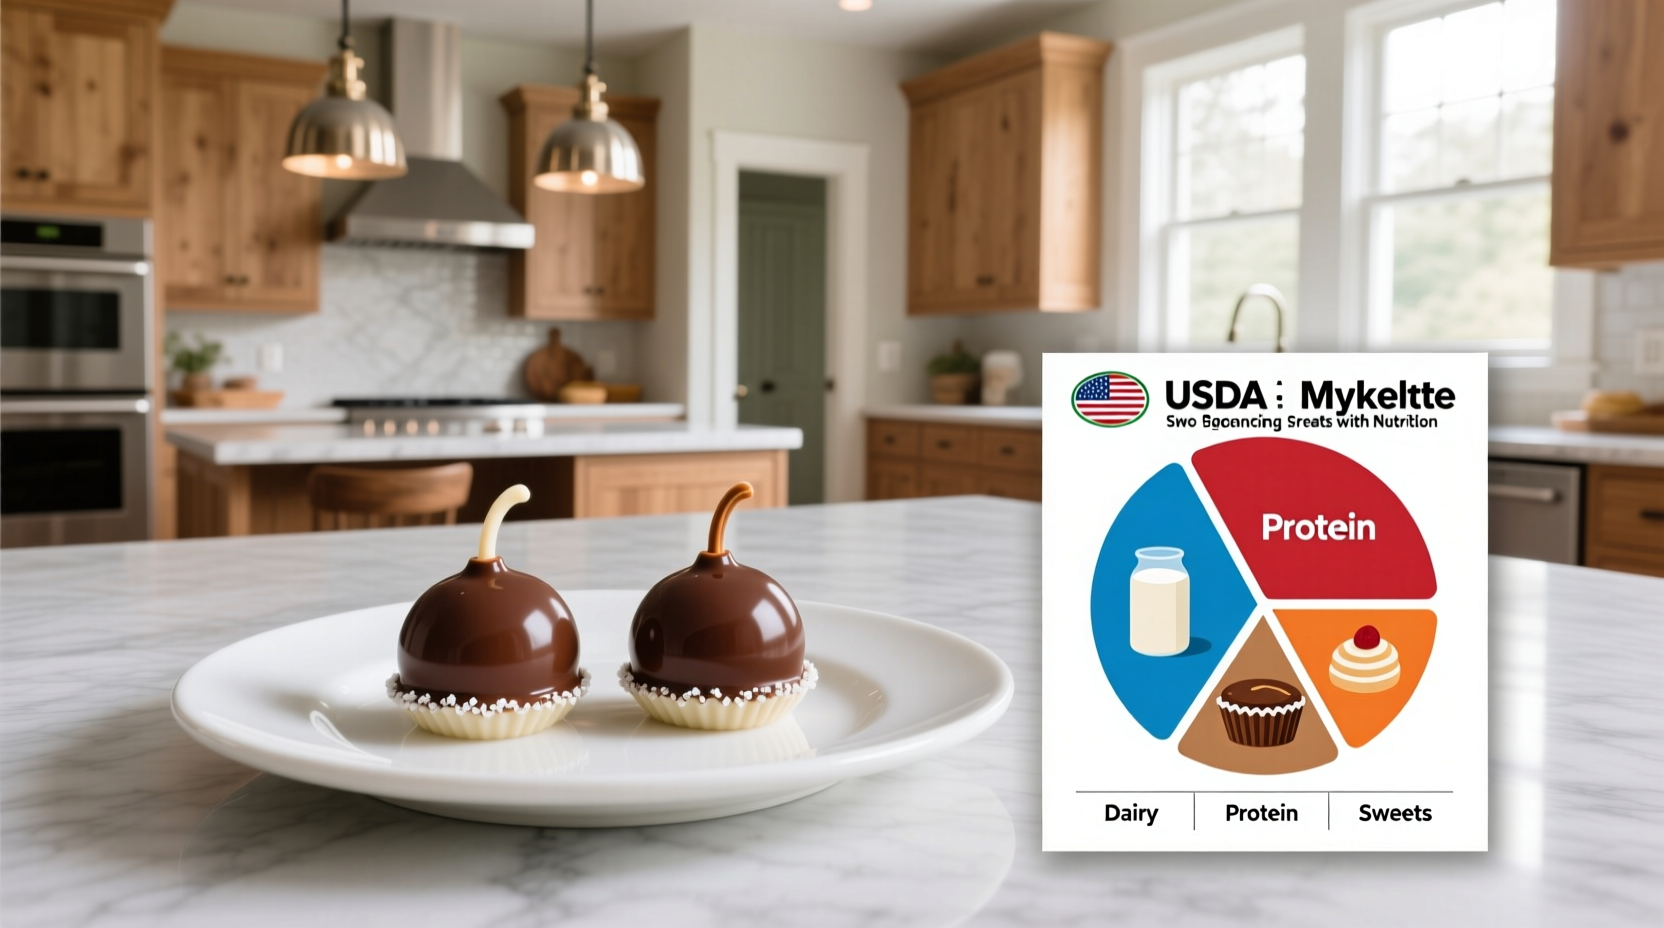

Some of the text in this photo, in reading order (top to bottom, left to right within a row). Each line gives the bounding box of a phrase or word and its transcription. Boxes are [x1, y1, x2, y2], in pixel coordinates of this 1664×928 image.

[1166, 379, 1267, 410] USDA
[1301, 379, 1456, 416] Mykeltte
[1166, 415, 1197, 428] Swo
[1287, 415, 1333, 428] Sreats
[1336, 414, 1370, 428] with
[1261, 512, 1376, 541] Protein
[1105, 802, 1159, 827] Dairy
[1226, 802, 1298, 822] Protein
[1358, 803, 1433, 822] Sweets
